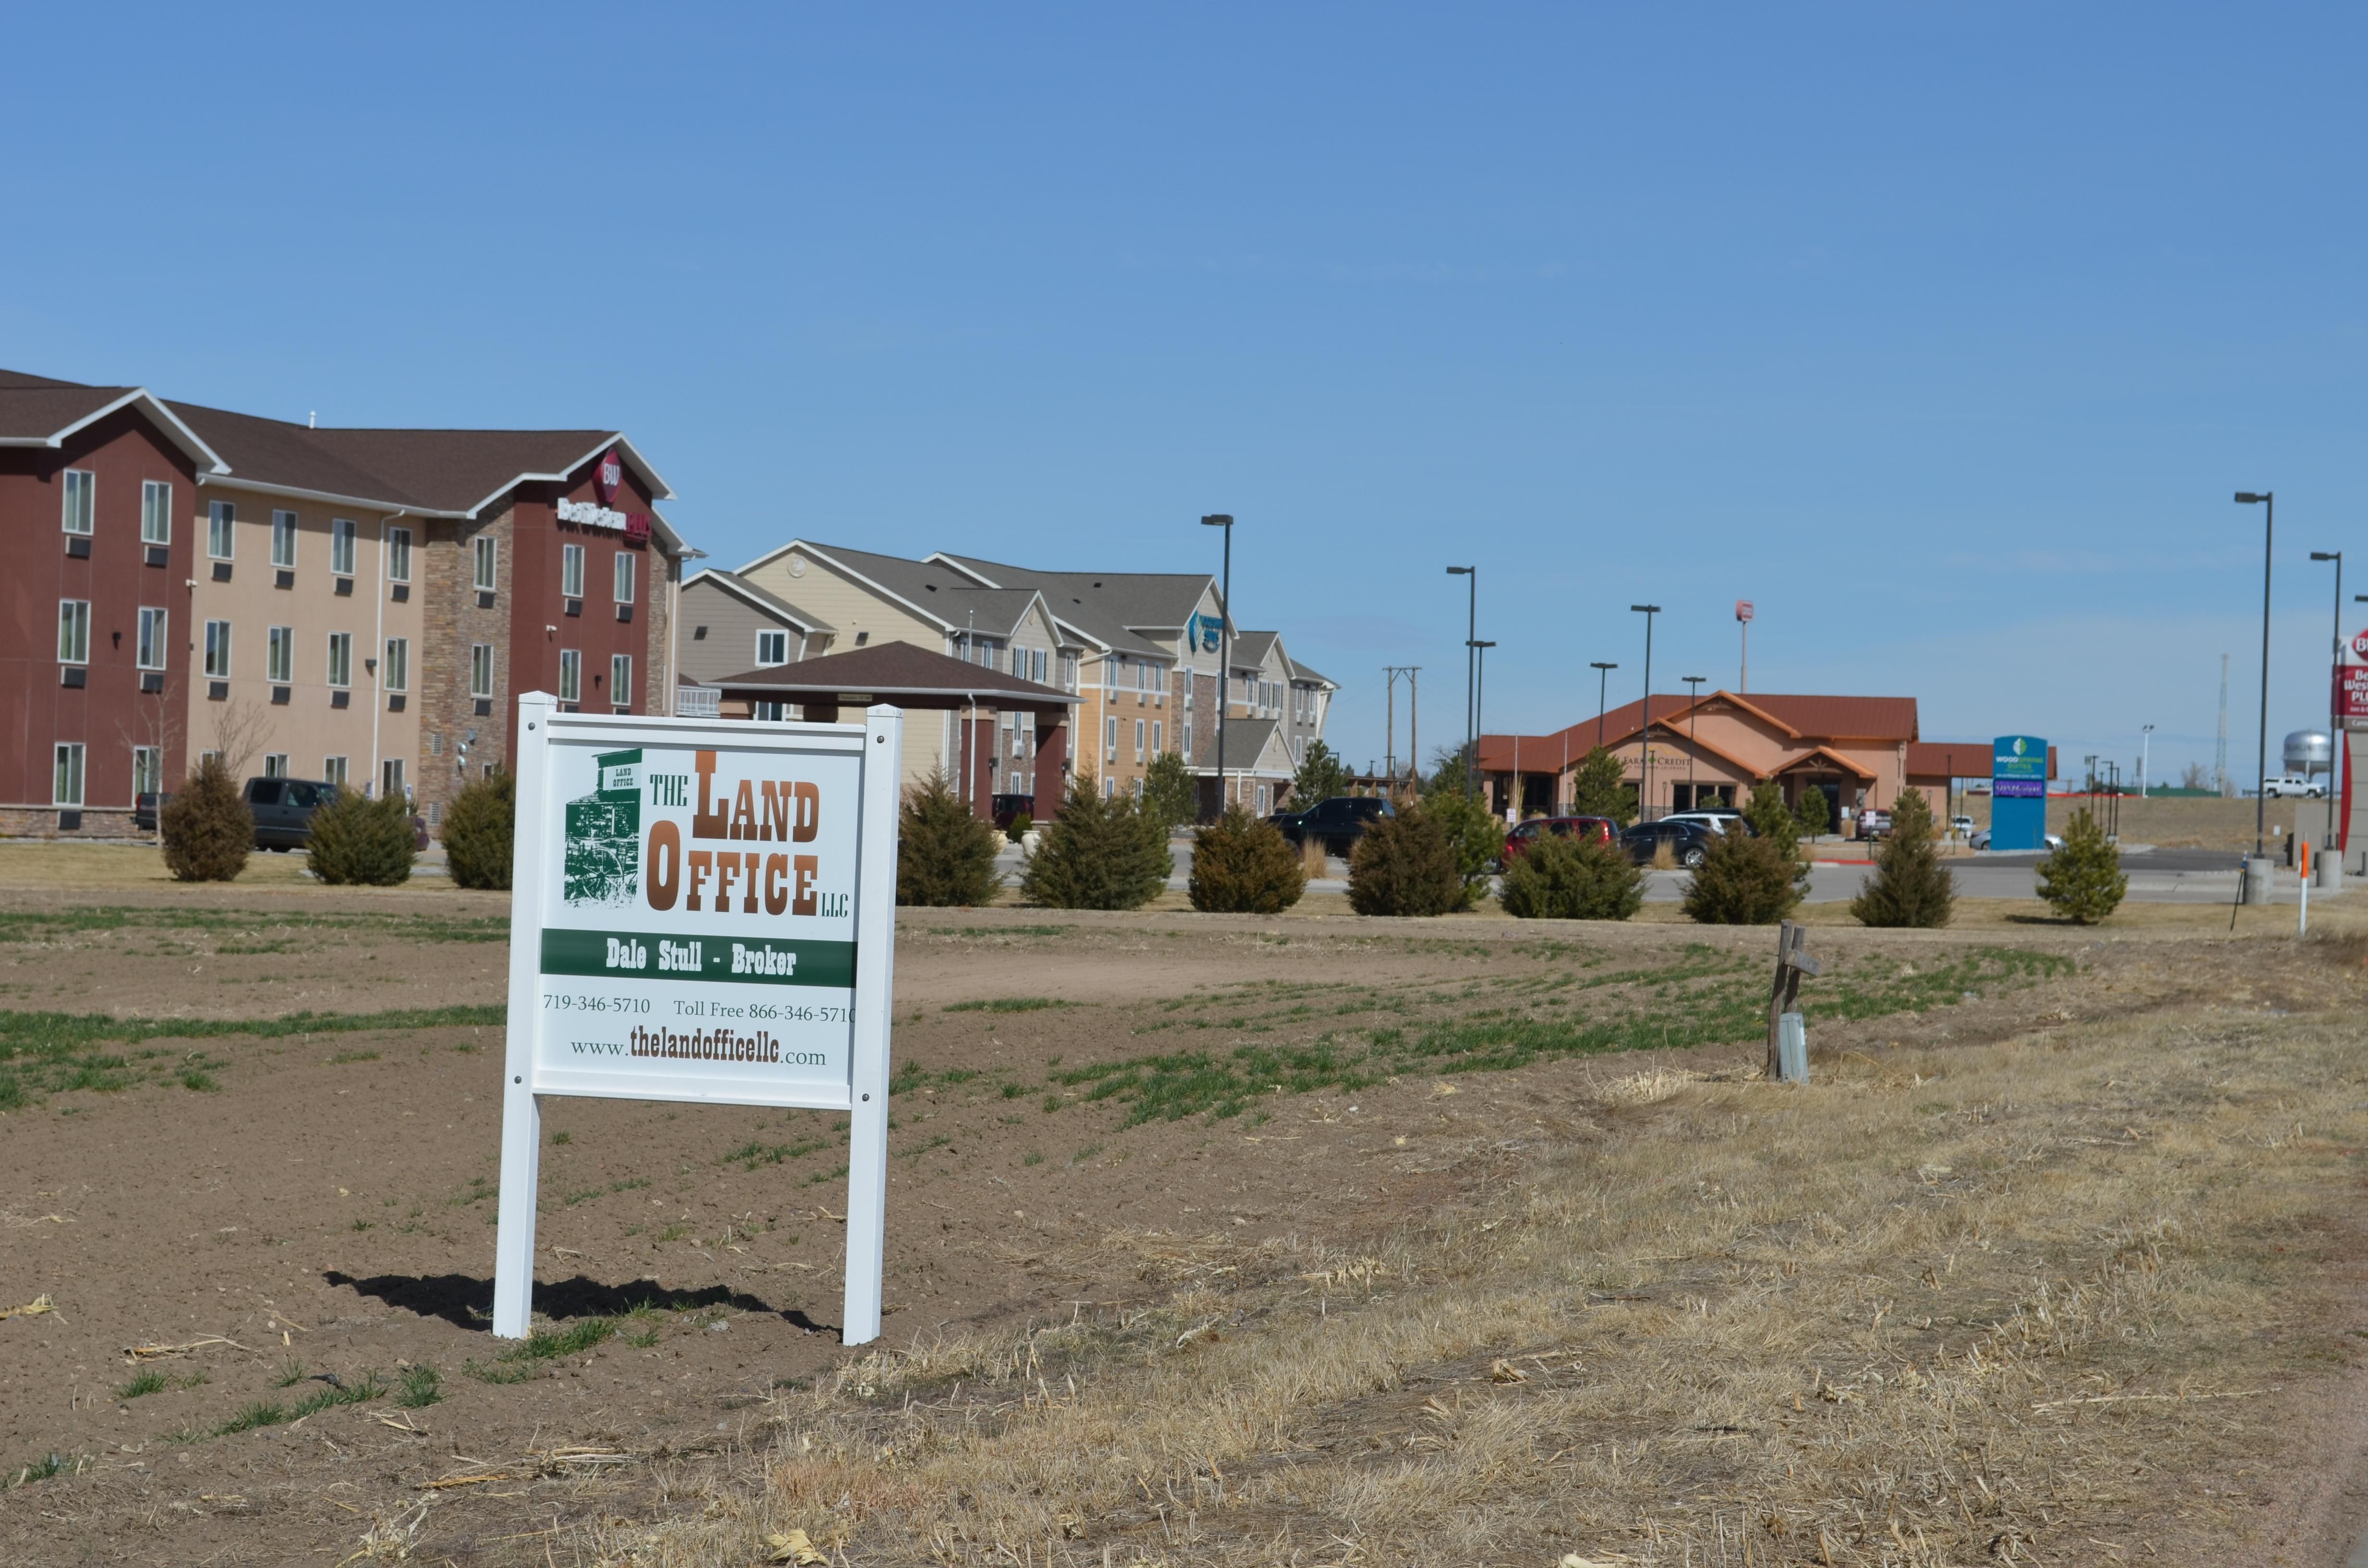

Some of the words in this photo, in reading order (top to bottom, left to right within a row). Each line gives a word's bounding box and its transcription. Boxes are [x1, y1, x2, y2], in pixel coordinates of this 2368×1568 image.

[604, 463, 620, 486] BW
[2356, 637, 2368, 652] B
[2343, 679, 2368, 691] Wes
[616, 768, 631, 776] LAND
[1658, 757, 1691, 766] CREDIT
[613, 778, 633, 787] OFFICE
[650, 774, 688, 806] THE
[692, 750, 819, 843] LAND
[646, 820, 818, 916] OFFICE
[821, 893, 848, 918] LLC
[606, 938, 646, 969] Dale
[659, 940, 702, 971] Stull
[731, 943, 796, 975] Broker
[543, 994, 650, 1013] 719-346-5710
[674, 1001, 705, 1016] Toll
[710, 1002, 744, 1017] Free
[570, 1025, 826, 1066] www.thelandofficellc.com
